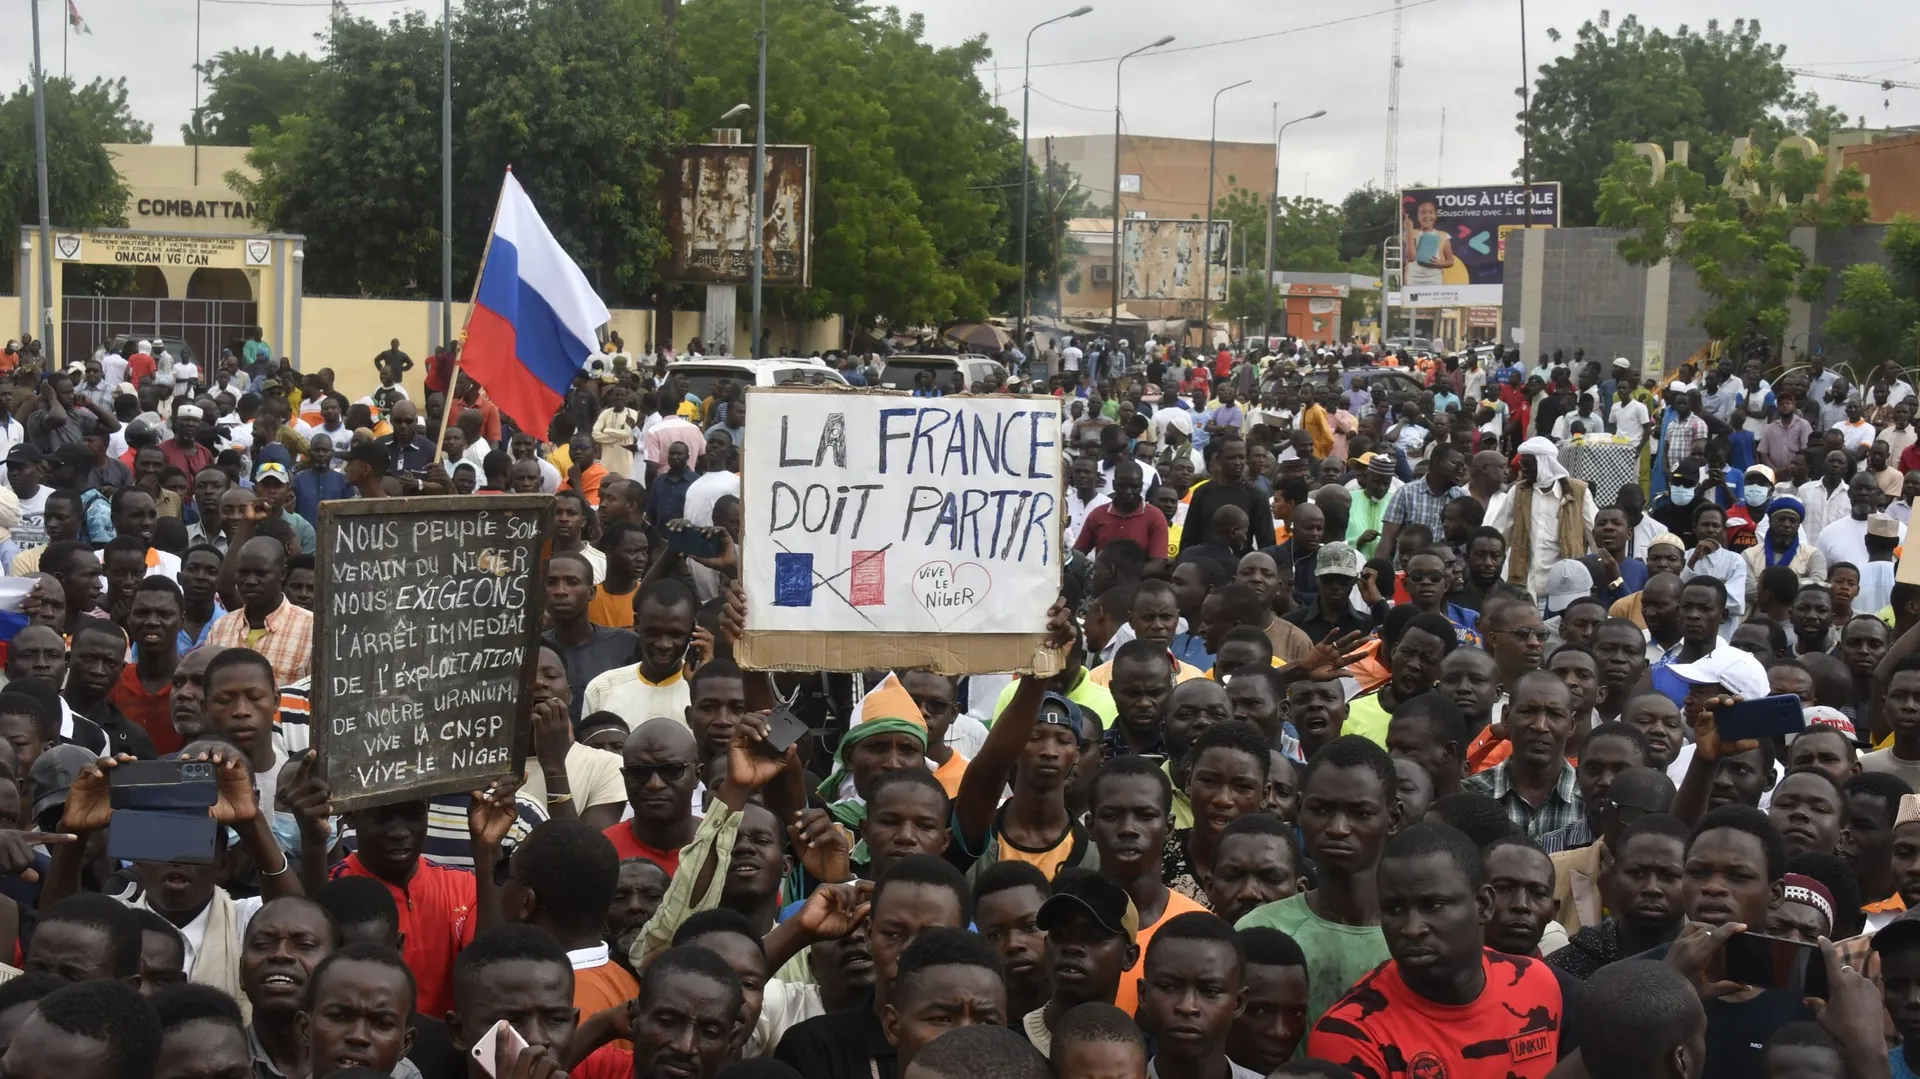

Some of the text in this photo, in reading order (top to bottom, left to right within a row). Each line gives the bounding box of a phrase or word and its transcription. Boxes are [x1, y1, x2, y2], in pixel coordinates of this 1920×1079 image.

[1436, 194, 1477, 207] TOUS
[1479, 191, 1491, 206] À
[1437, 209, 1481, 217] Souscrivez
[1482, 209, 1502, 217] avec
[780, 407, 1056, 479] LA FRANCE
[336, 520, 399, 554] NOUS
[332, 555, 407, 583] VERAIN
[417, 556, 439, 577] DU
[935, 579, 949, 589] LE
[334, 590, 388, 616] NOUS
[333, 675, 364, 697] DE
[333, 717, 362, 736] DE
[414, 722, 429, 746] LA
[440, 715, 504, 741] CNSP
[418, 751, 440, 775] LE
[1515, 1037, 1547, 1057] UNKUT
